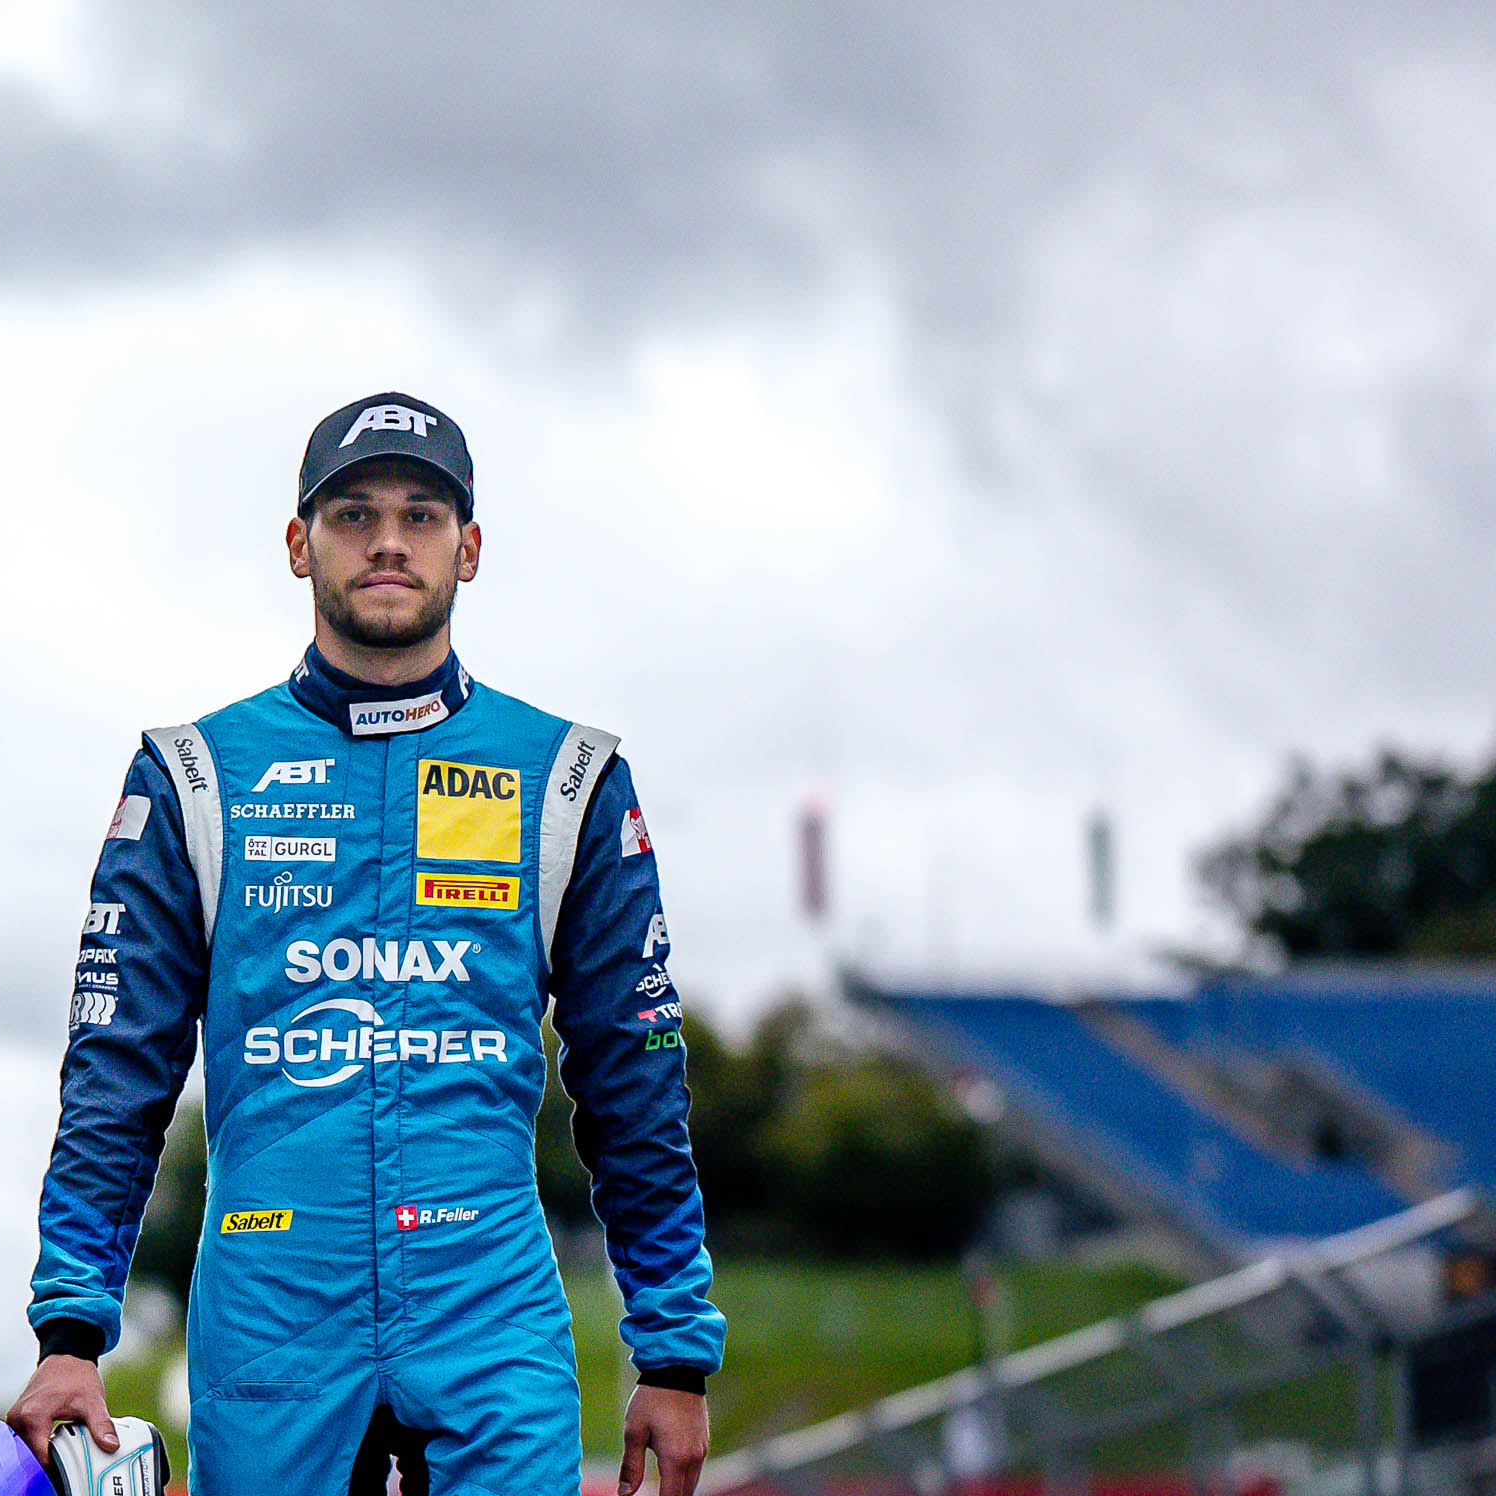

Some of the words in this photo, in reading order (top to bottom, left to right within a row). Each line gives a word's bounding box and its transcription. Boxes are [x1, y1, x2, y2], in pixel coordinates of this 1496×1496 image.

[338, 404, 437, 448] ABT
[355, 699, 441, 726] AUTOHERO
[175, 738, 209, 793] Sabelt
[250, 758, 336, 793] ABT
[422, 763, 516, 800] ADAC
[561, 738, 596, 801] Sabelt
[230, 803, 356, 819] SCHAEFFLER
[274, 842, 333, 857] GURGL
[244, 881, 334, 914] FUJITSU
[424, 879, 510, 902] PIRELLI
[284, 937, 472, 983] SONAX
[243, 1026, 508, 1065] SCHERER
[226, 1212, 287, 1231] Sabelt
